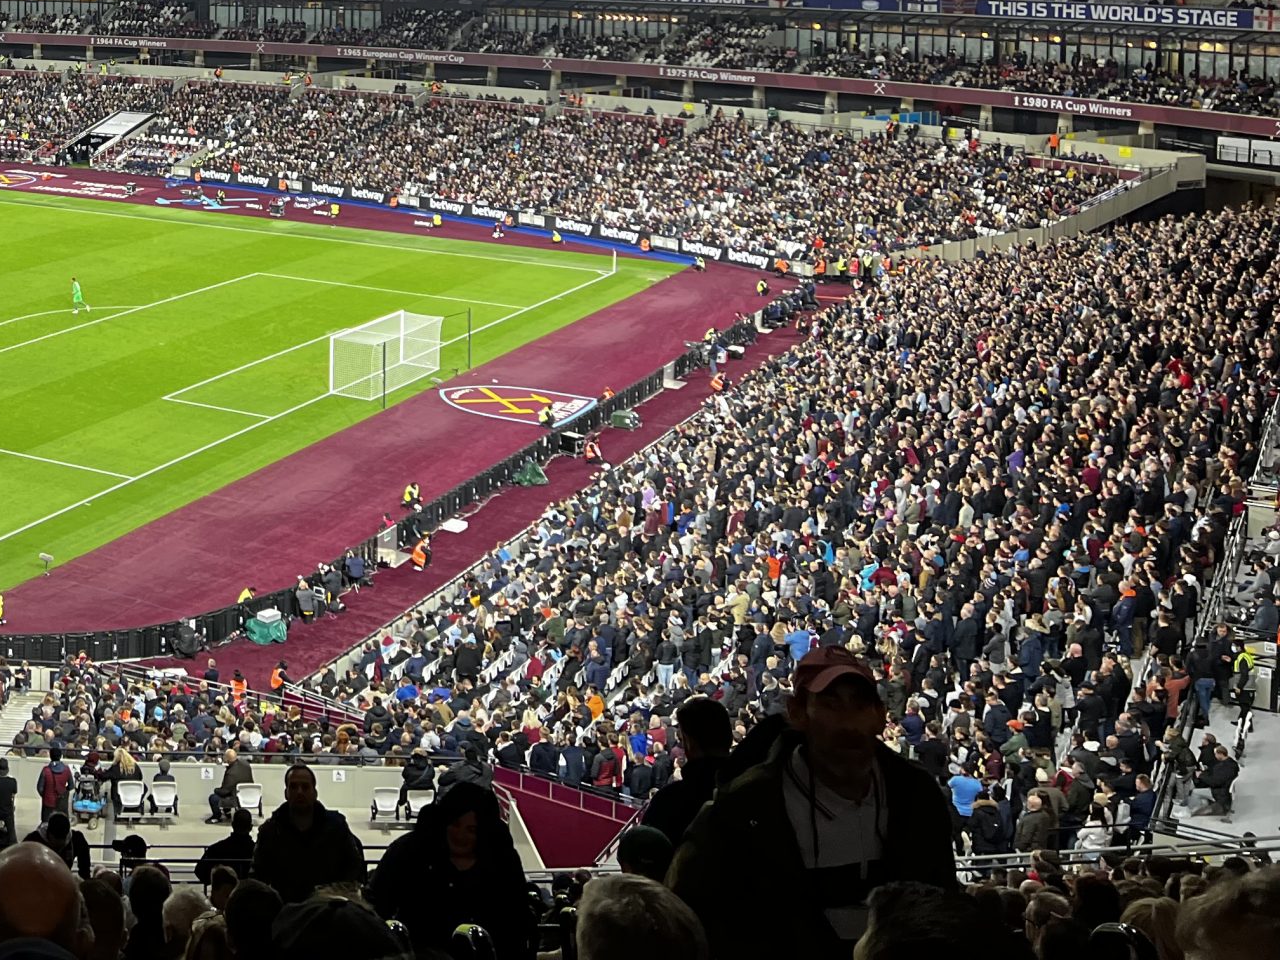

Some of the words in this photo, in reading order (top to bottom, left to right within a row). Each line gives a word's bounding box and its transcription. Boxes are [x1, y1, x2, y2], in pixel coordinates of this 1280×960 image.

[988, 0, 1028, 17] THIS
[1031, 2, 1048, 18] IS
[1051, 3, 1086, 19] THE
[1090, 4, 1174, 23] WORLD'S
[1177, 8, 1238, 27] STAGE
[96, 37, 113, 45] 1964
[124, 39, 138, 47] Cup
[343, 48, 361, 56] 1965
[362, 49, 398, 60] European
[399, 51, 414, 61] Cup
[449, 55, 464, 64] Cup
[666, 69, 686, 77] 1975
[688, 70, 700, 78] FA
[701, 71, 718, 80] Cup
[720, 72, 755, 82] Winners
[1022, 97, 1048, 108] 1980
[1050, 99, 1063, 110] FA
[1065, 101, 1087, 114] Cup
[1088, 103, 1132, 116] Winners
[200, 168, 231, 182] betway
[238, 172, 269, 188] betway
[311, 181, 344, 197] betway
[351, 187, 385, 203] betway
[429, 198, 464, 214] betway
[471, 204, 507, 221] betway
[555, 218, 593, 236] betway
[600, 224, 639, 244] betway
[681, 239, 723, 260] betway
[728, 247, 769, 269] betway
